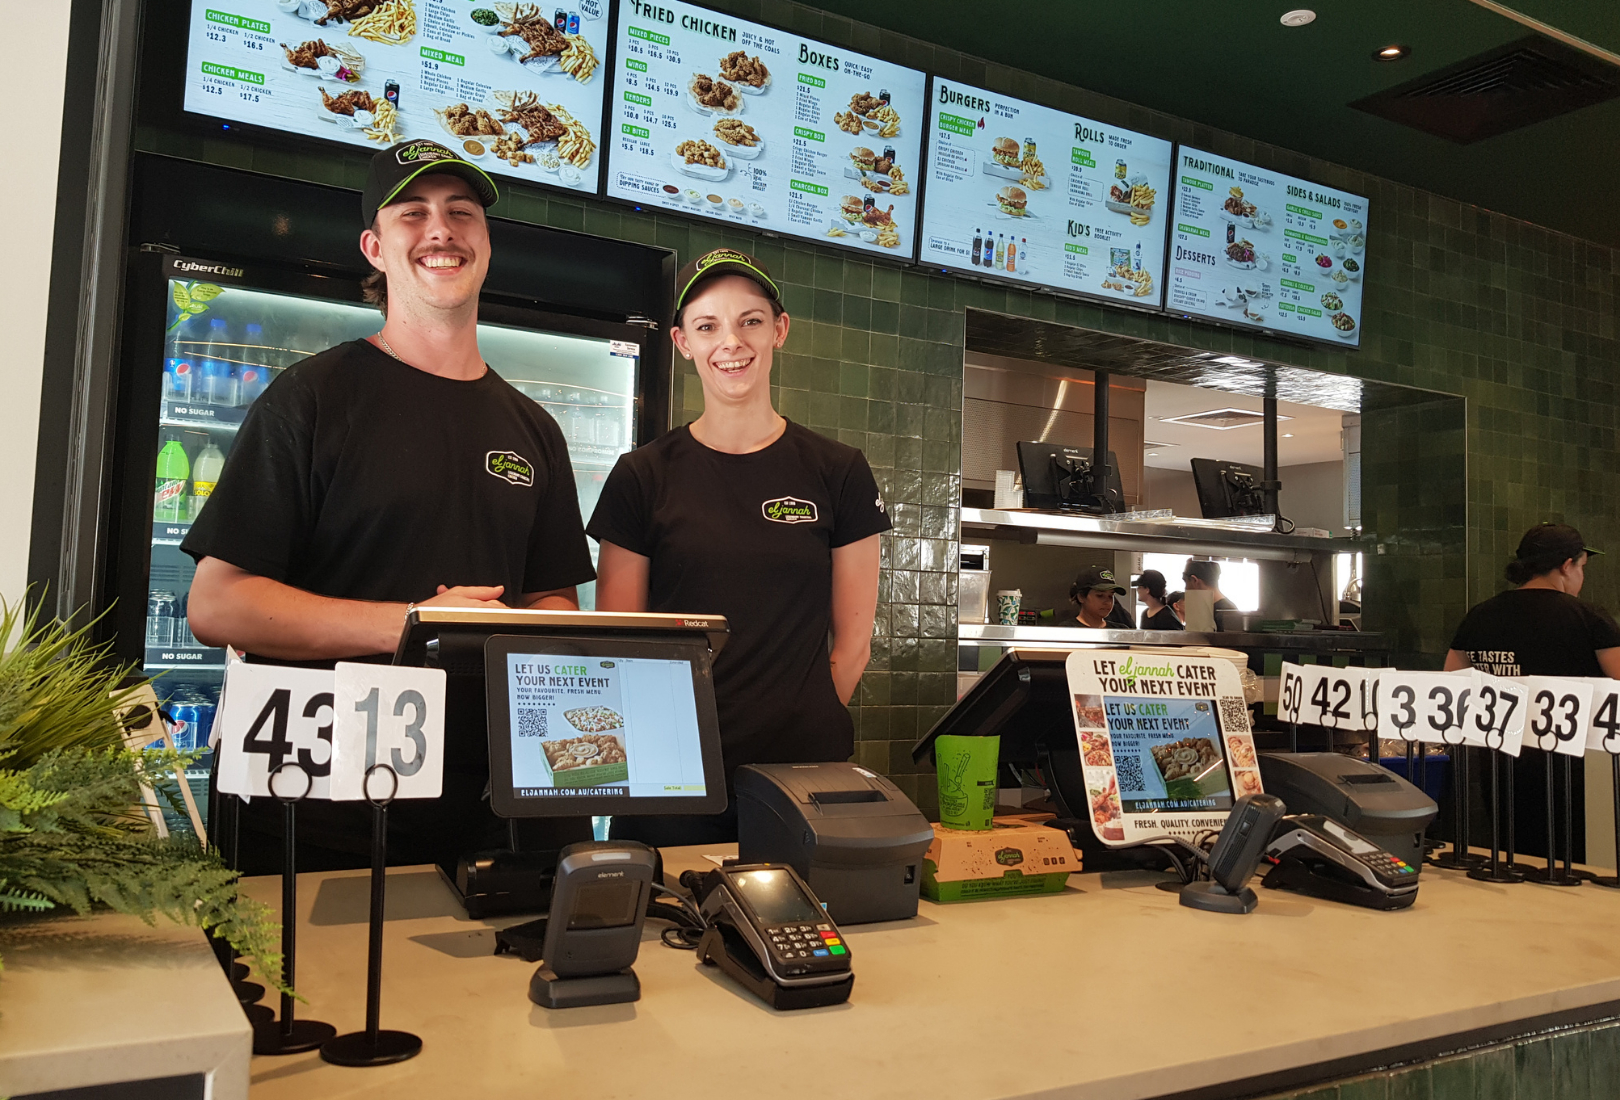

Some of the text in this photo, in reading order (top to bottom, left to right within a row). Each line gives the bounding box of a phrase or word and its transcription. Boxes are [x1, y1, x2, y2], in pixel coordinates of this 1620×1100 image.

[582, 4, 600, 17] VALUE
[586, 0, 598, 8] HOT
[207, 12, 269, 32] CHICKEN PLATES
[631, 0, 737, 42] FRIED CHICKEN
[218, 27, 239, 36] CHICKEN
[630, 28, 669, 44] MIXED PIECES
[742, 31, 758, 41] JUICY
[764, 37, 775, 45] HOT
[254, 36, 276, 44] CHICKEN
[753, 41, 764, 49] THE
[422, 48, 464, 65] MIXED MEAL
[628, 60, 646, 70] WINGS
[860, 65, 873, 74] EASY
[203, 64, 264, 83] CHICKEN MEALS
[214, 79, 236, 87] CHICKEN
[251, 86, 272, 95] CHICKEN
[626, 92, 650, 105] TENDERS
[632, 128, 648, 137] BITES
[1184, 156, 1235, 179] TRADITIONAL
[619, 180, 660, 194] DIPPING SAUCES
[1286, 185, 1306, 199] SIDES
[1308, 191, 1313, 201] &
[1315, 193, 1341, 209] SALADS
[173, 259, 244, 278] CyberChill
[189, 408, 214, 417] SUGAR
[684, 619, 708, 628] Redcat
[1478, 651, 1515, 663] TASTES
[515, 664, 587, 676] LET US CATER
[1093, 660, 1116, 675] LET
[1176, 664, 1217, 681] CATER
[1493, 664, 1521, 676] WITH
[516, 675, 610, 688] YOUR NEXT EVENT
[1098, 677, 1217, 697] YOUR NEXT EVENT
[1283, 673, 1302, 713] 50
[1311, 677, 1351, 719] 42
[1105, 703, 1168, 716] LET US CATER
[1475, 686, 1519, 736] 37
[1531, 690, 1580, 741] 33
[1108, 718, 1190, 731] YOUR NEXT EVENT
[242, 688, 334, 777] 43
[355, 687, 426, 776] 13
[521, 787, 624, 797] ELJANNAH.COM.AU/CATERING
